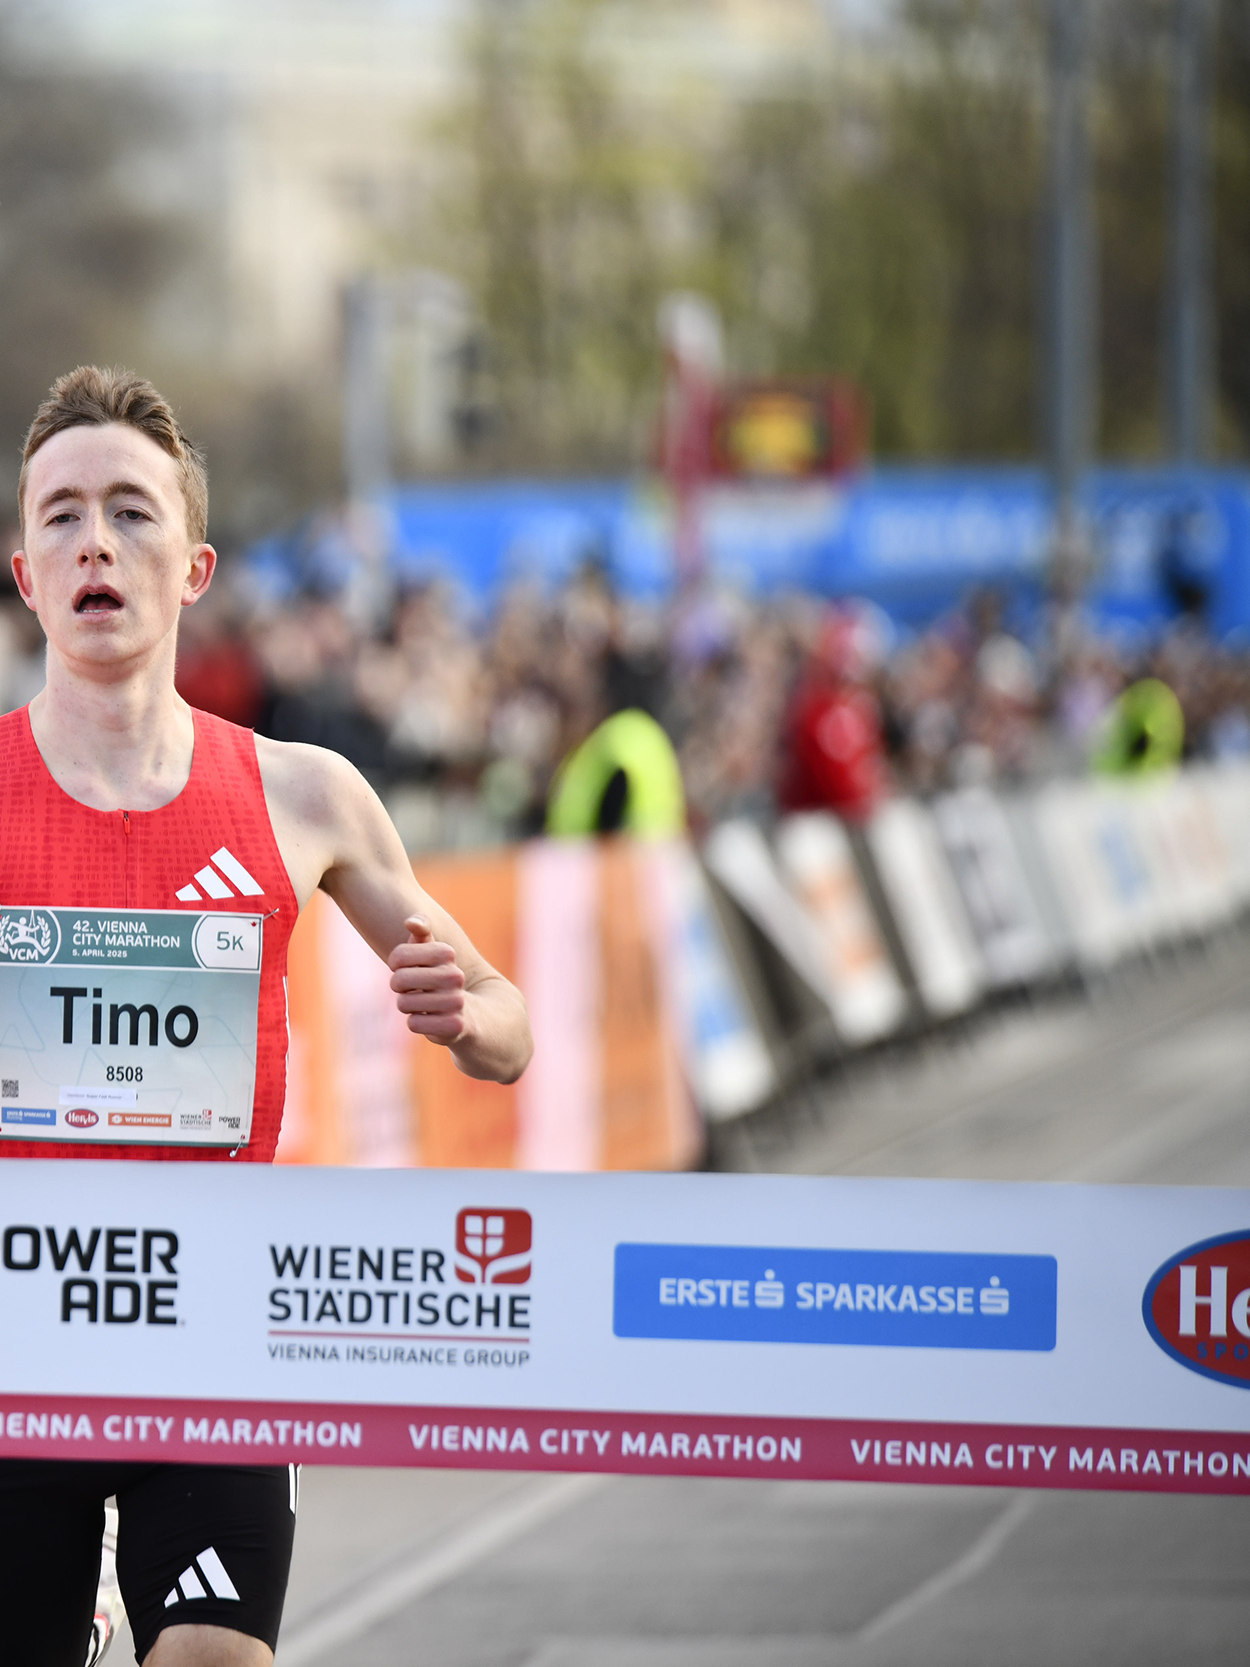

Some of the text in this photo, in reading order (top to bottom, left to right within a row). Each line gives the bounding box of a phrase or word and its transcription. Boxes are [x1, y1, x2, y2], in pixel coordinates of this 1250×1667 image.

[72, 933, 180, 948] CITY MARATHON
[73, 920, 148, 934] 42. VIENNA
[9, 948, 39, 961] VCM
[72, 949, 128, 958] 5. APRIL 2025
[50, 987, 199, 1048] Timo
[106, 1066, 143, 1083] 8508
[68, 1112, 97, 1125] Hervis
[269, 1244, 447, 1284] WIENER
[60, 1277, 179, 1326] ADE
[267, 1286, 532, 1329] STÄDTISCHE
[659, 1276, 750, 1308] ERSTE
[795, 1280, 975, 1316] SPARKASSE
[267, 1342, 531, 1368] VIENNA INSURANCE GROUP
[102, 1414, 175, 1443] CITY
[182, 1417, 363, 1448] MARATHON
[408, 1423, 803, 1463] VIENNA CITY MARATHON
[850, 1438, 1250, 1479] VIENNA CITY MARATHON
